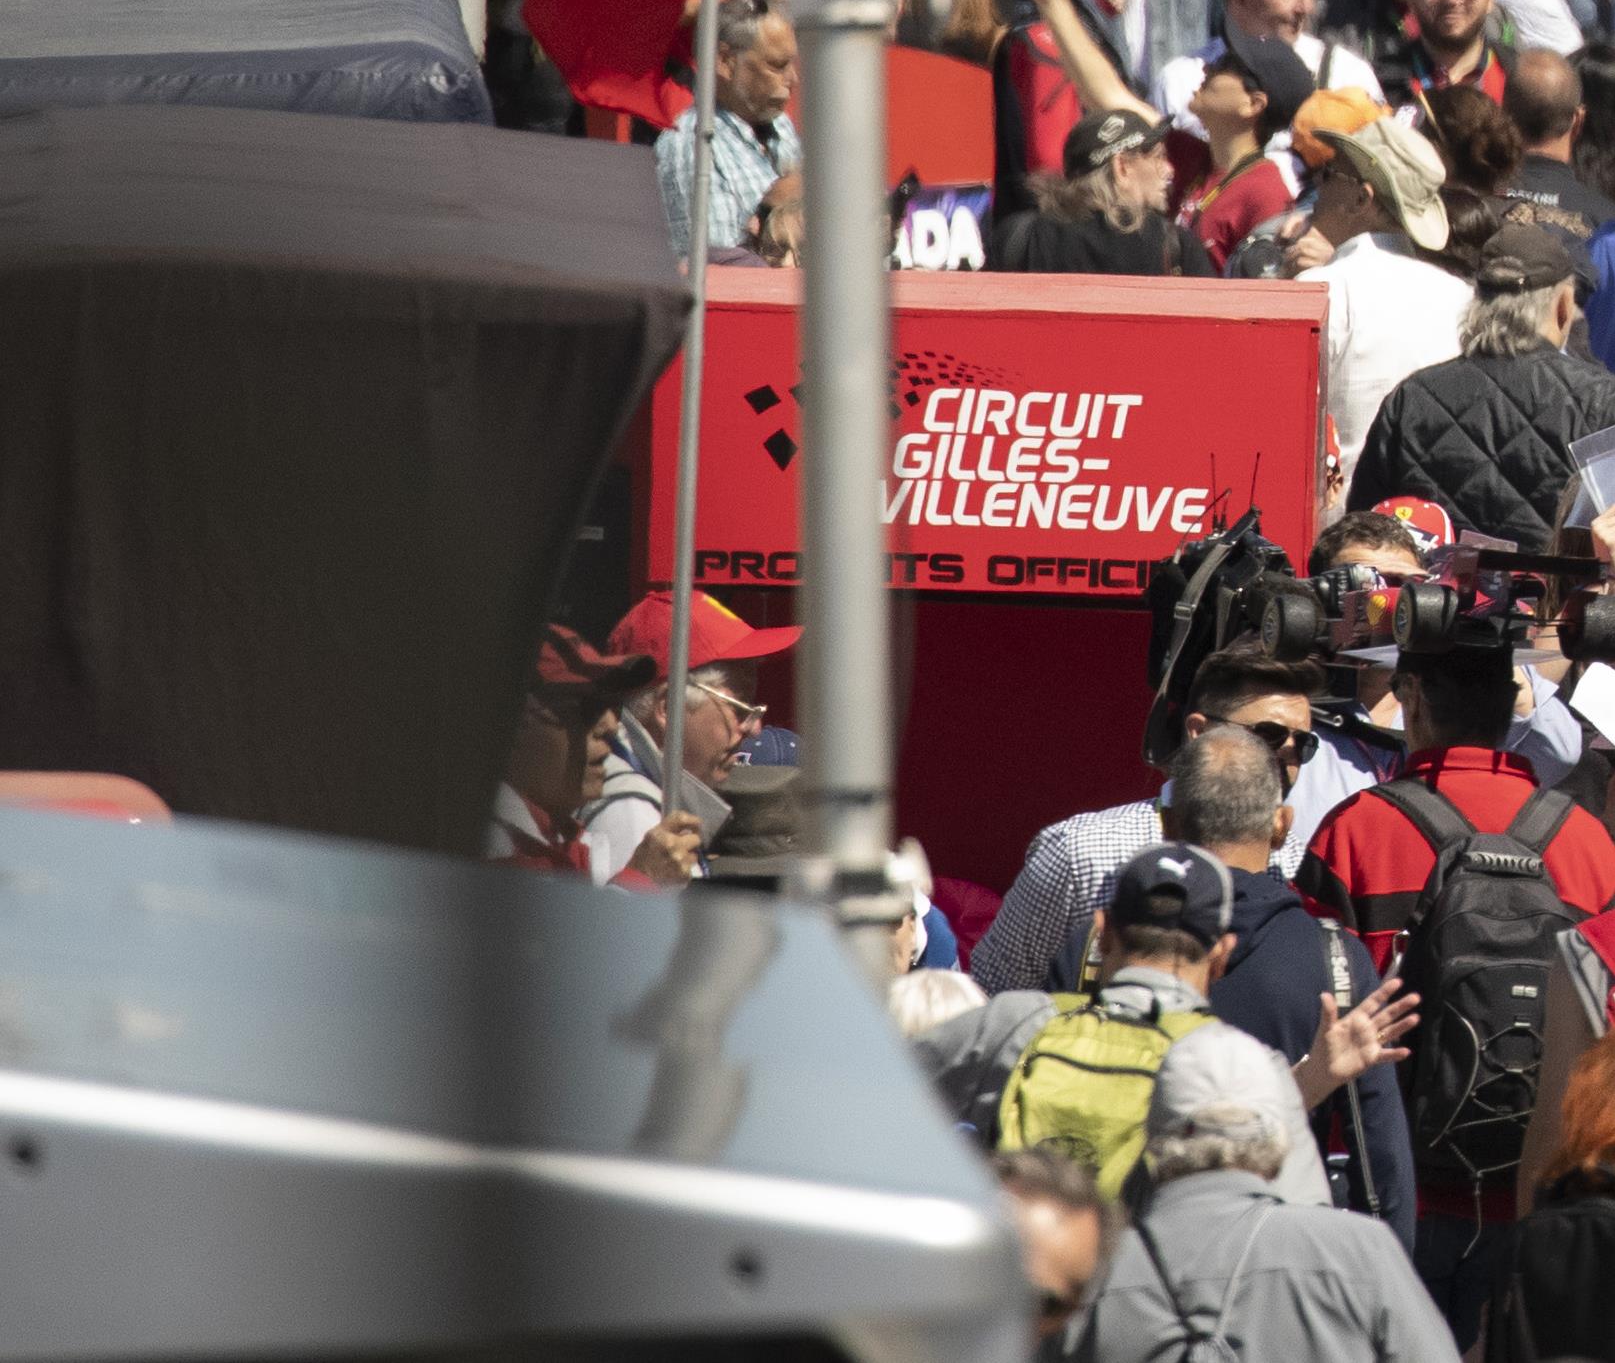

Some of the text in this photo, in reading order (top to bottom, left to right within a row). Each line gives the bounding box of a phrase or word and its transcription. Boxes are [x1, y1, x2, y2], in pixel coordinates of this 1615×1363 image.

[884, 205, 986, 270] ADA
[922, 388, 1142, 438] CIRCUIT
[892, 433, 1110, 482] GILLES-
[877, 479, 1209, 533] VILLENEUVE
[696, 550, 1148, 589] PROITS OFFICI
